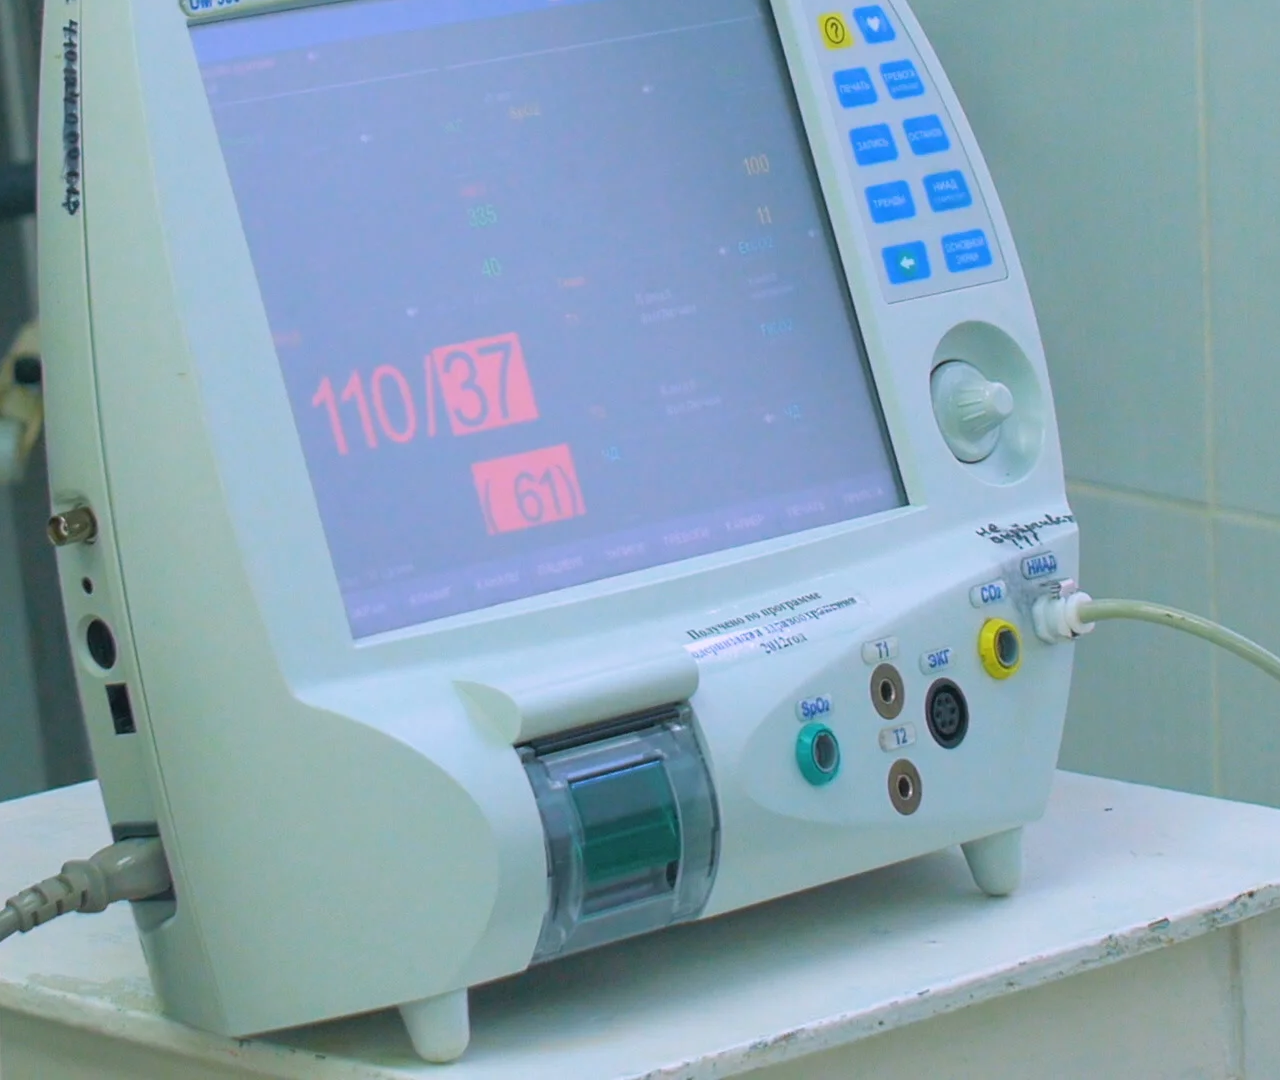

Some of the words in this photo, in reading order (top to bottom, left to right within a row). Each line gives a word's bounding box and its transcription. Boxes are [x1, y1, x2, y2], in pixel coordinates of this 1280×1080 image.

[742, 153, 770, 177] 100
[757, 205, 773, 225] 11
[481, 257, 502, 278] 40
[1026, 554, 1058, 576] НИАД
[686, 615, 746, 641] Получено
[760, 591, 823, 619] программе
[875, 640, 890, 660] T1
[927, 648, 951, 669] ЭКГ
[892, 727, 908, 746] T2
